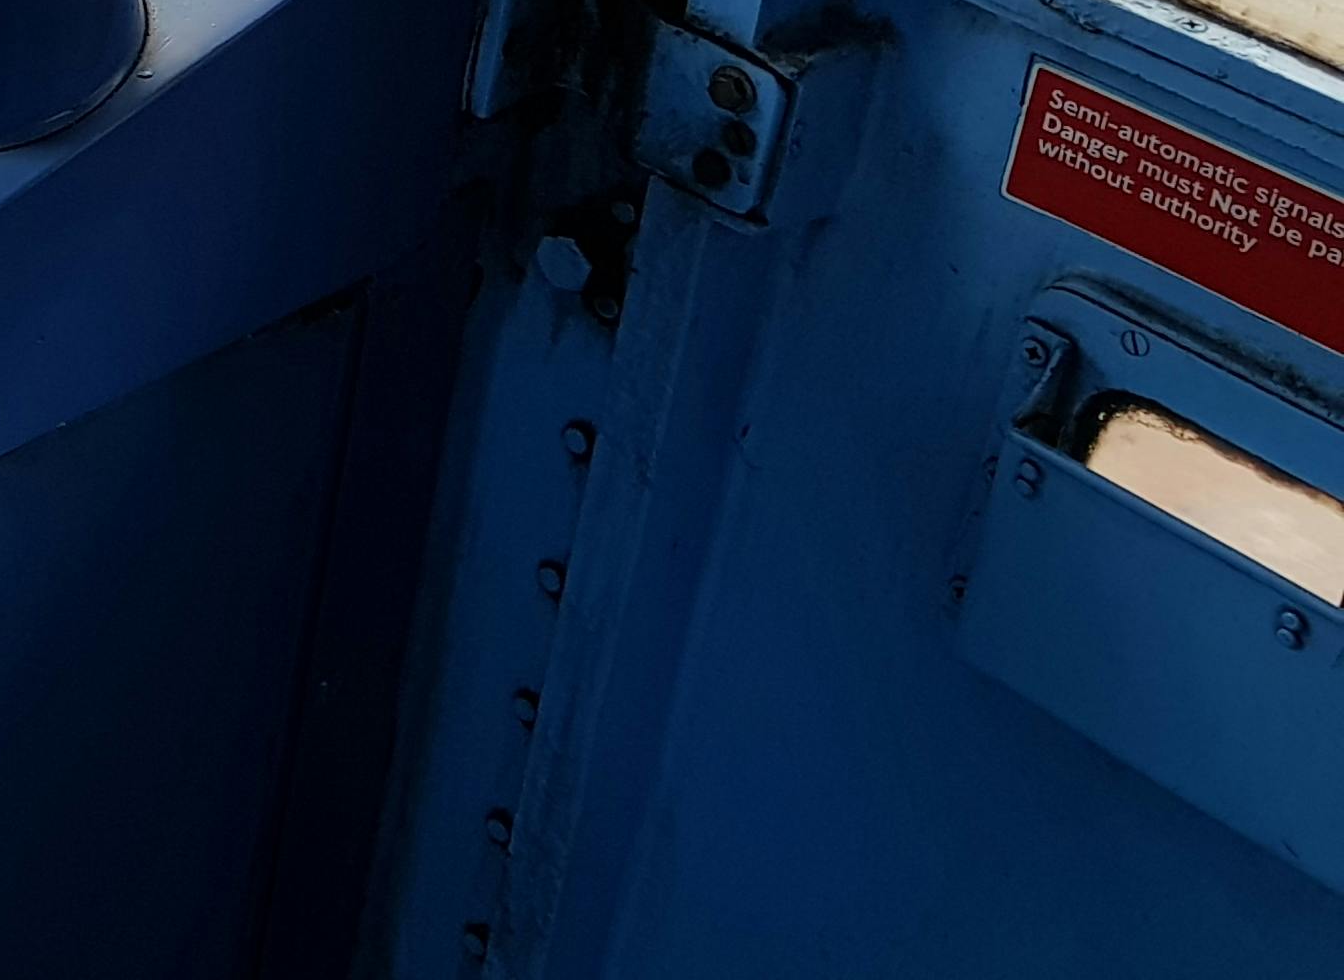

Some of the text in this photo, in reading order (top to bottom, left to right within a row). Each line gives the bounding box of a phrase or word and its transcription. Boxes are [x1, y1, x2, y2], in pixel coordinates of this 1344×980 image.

[1038, 138, 1258, 253] without authority
[1042, 111, 1344, 268] Danger must Not be pa
[1048, 89, 1344, 239] Semi-automatic signals
